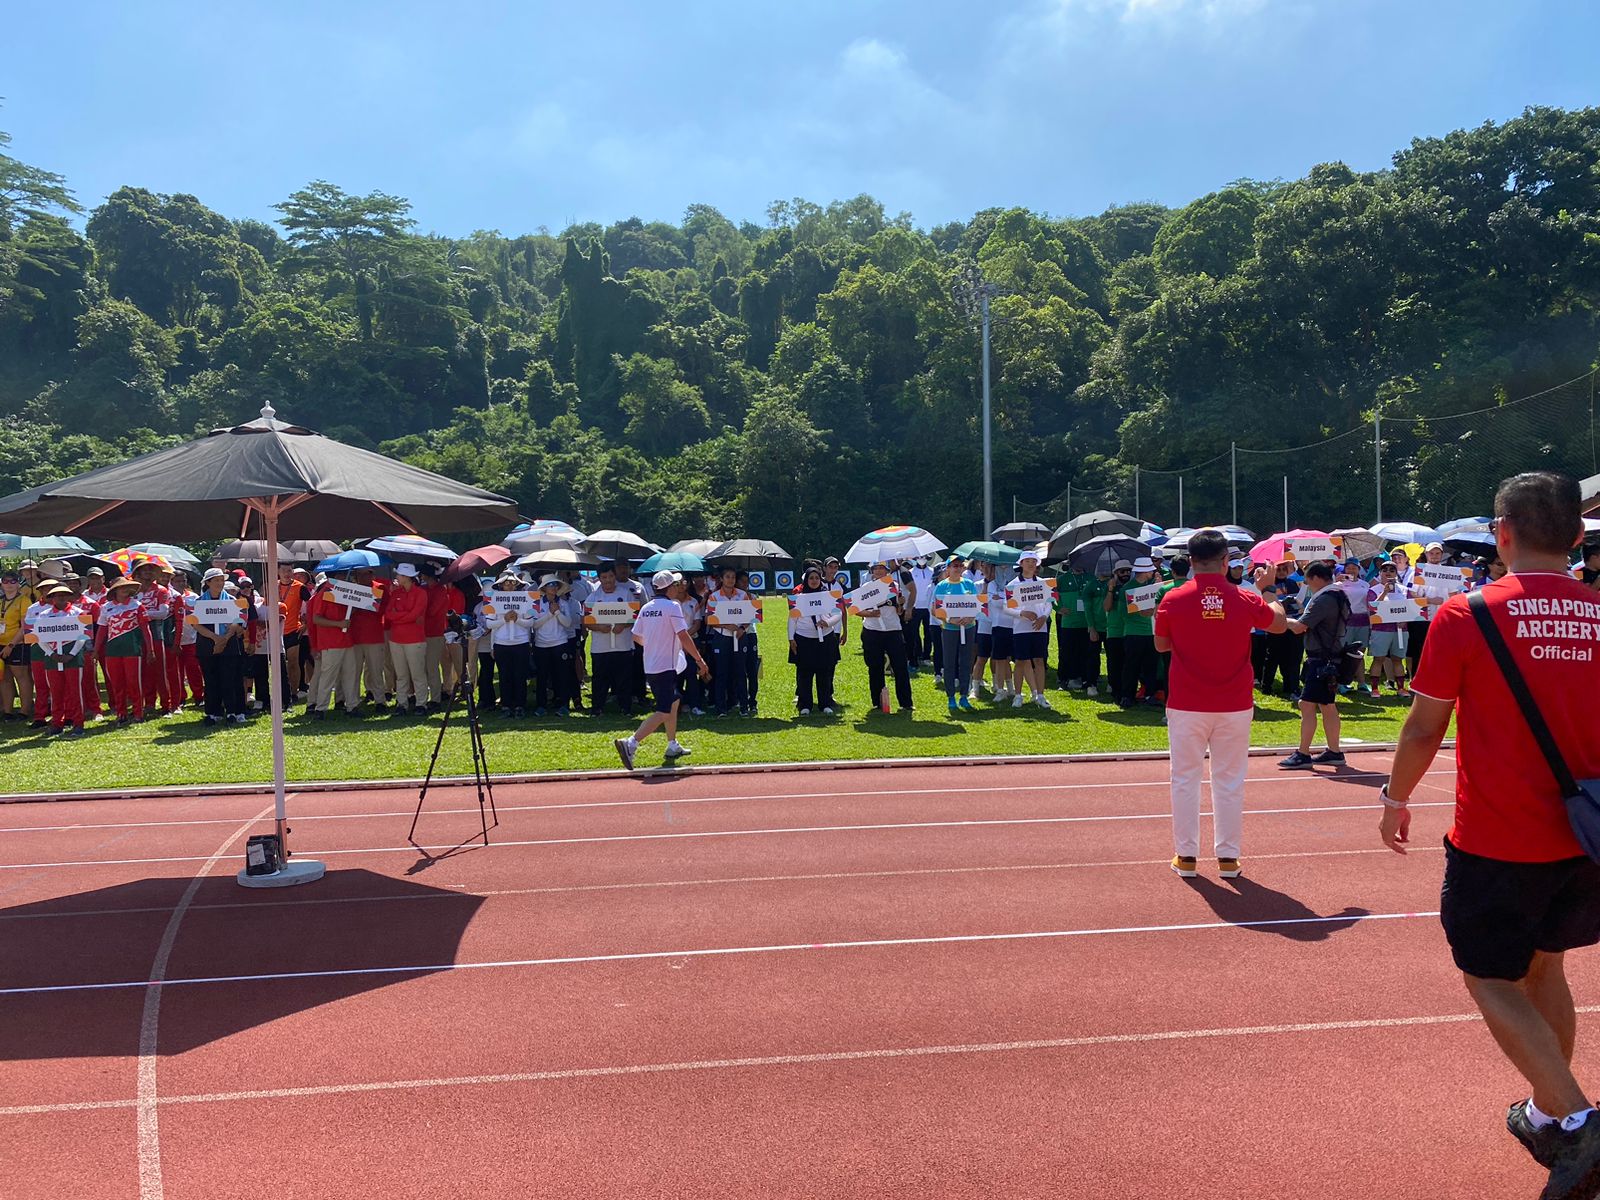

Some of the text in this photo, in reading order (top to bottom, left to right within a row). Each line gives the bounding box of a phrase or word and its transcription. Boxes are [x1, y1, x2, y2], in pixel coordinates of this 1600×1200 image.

[1438, 572, 1462, 580] Zealand
[861, 589, 880, 600] Jordan
[38, 624, 79, 633] Bangladesh
[1516, 620, 1600, 641] ARCHERY
[1530, 645, 1592, 661] Official
